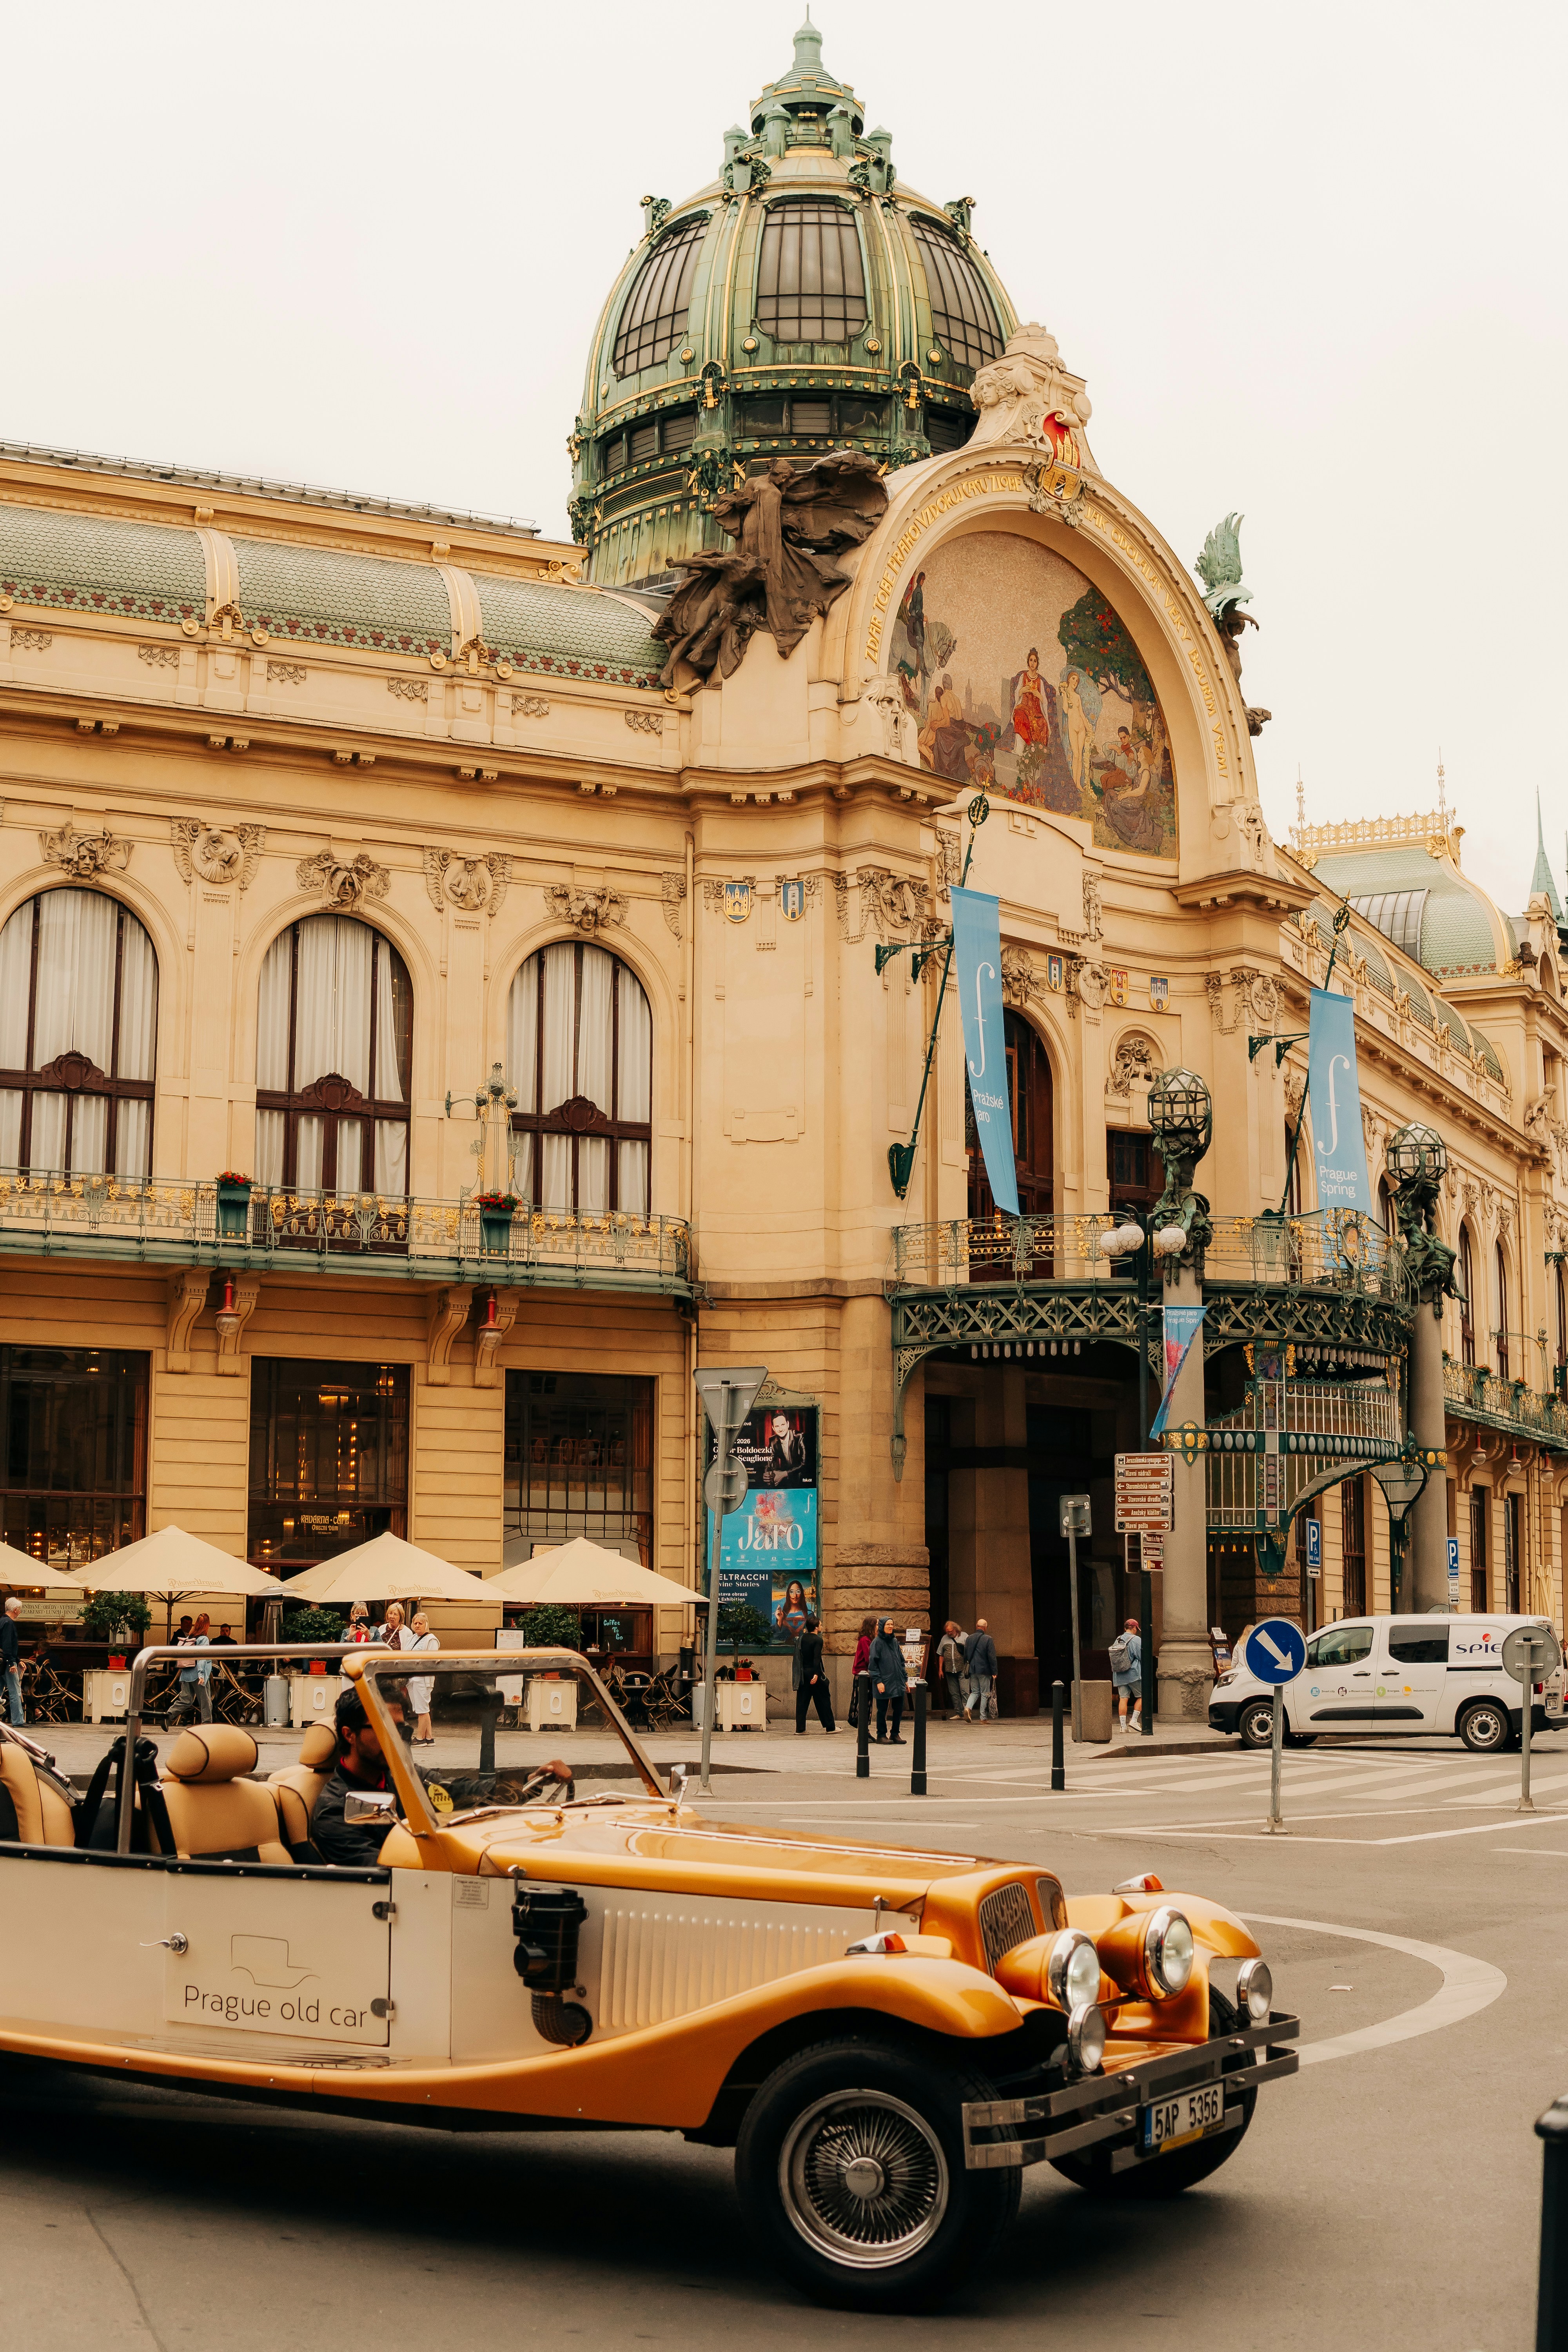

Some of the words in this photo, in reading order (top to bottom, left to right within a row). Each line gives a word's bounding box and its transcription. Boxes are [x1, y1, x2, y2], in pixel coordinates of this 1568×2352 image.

[915, 486, 964, 528] VZDORUJ
[1084, 506, 1109, 534] JAK
[1111, 528, 1163, 595] ODOLALAS
[973, 1089, 1004, 1110] Pražské
[976, 1106, 990, 1123] jaro
[1319, 1165, 1357, 1183] Prague
[1321, 1181, 1356, 1198] Spring
[738, 1455, 773, 1463] Scaglione
[738, 1515, 803, 1550] Jaro
[1310, 1526, 1318, 1551] P
[1449, 1543, 1456, 1565] P
[1455, 1643, 1502, 1653] SPIE
[185, 1985, 270, 2022] Prague
[281, 1996, 319, 2023] old
[330, 2007, 367, 2028] car
[1155, 2103, 1179, 2140] 5AP
[1189, 2089, 1219, 2128] 5356
